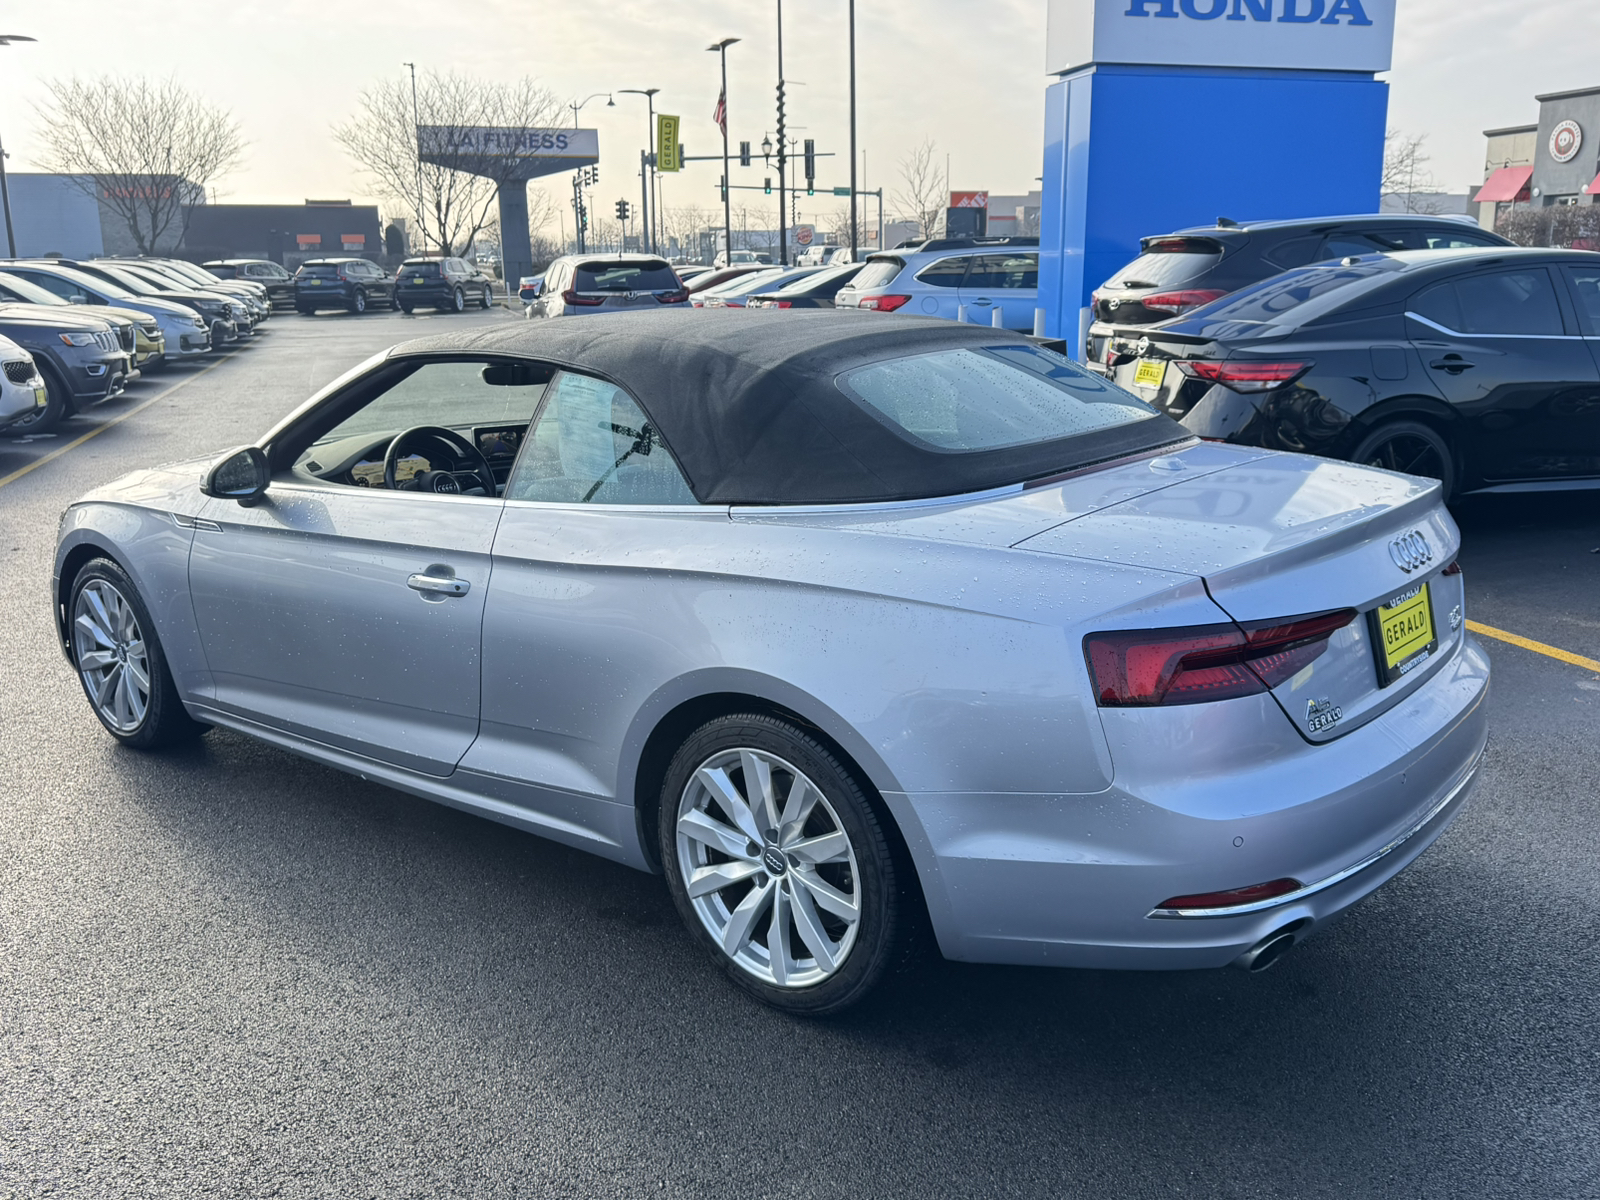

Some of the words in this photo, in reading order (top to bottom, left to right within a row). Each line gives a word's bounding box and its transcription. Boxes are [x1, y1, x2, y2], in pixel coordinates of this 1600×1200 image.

[484, 133, 568, 150] FITNESS
[664, 122, 672, 166] GERALD
[1139, 367, 1160, 379] GERALD
[1386, 610, 1425, 645] GERALD
[1308, 706, 1343, 732] GERALD
